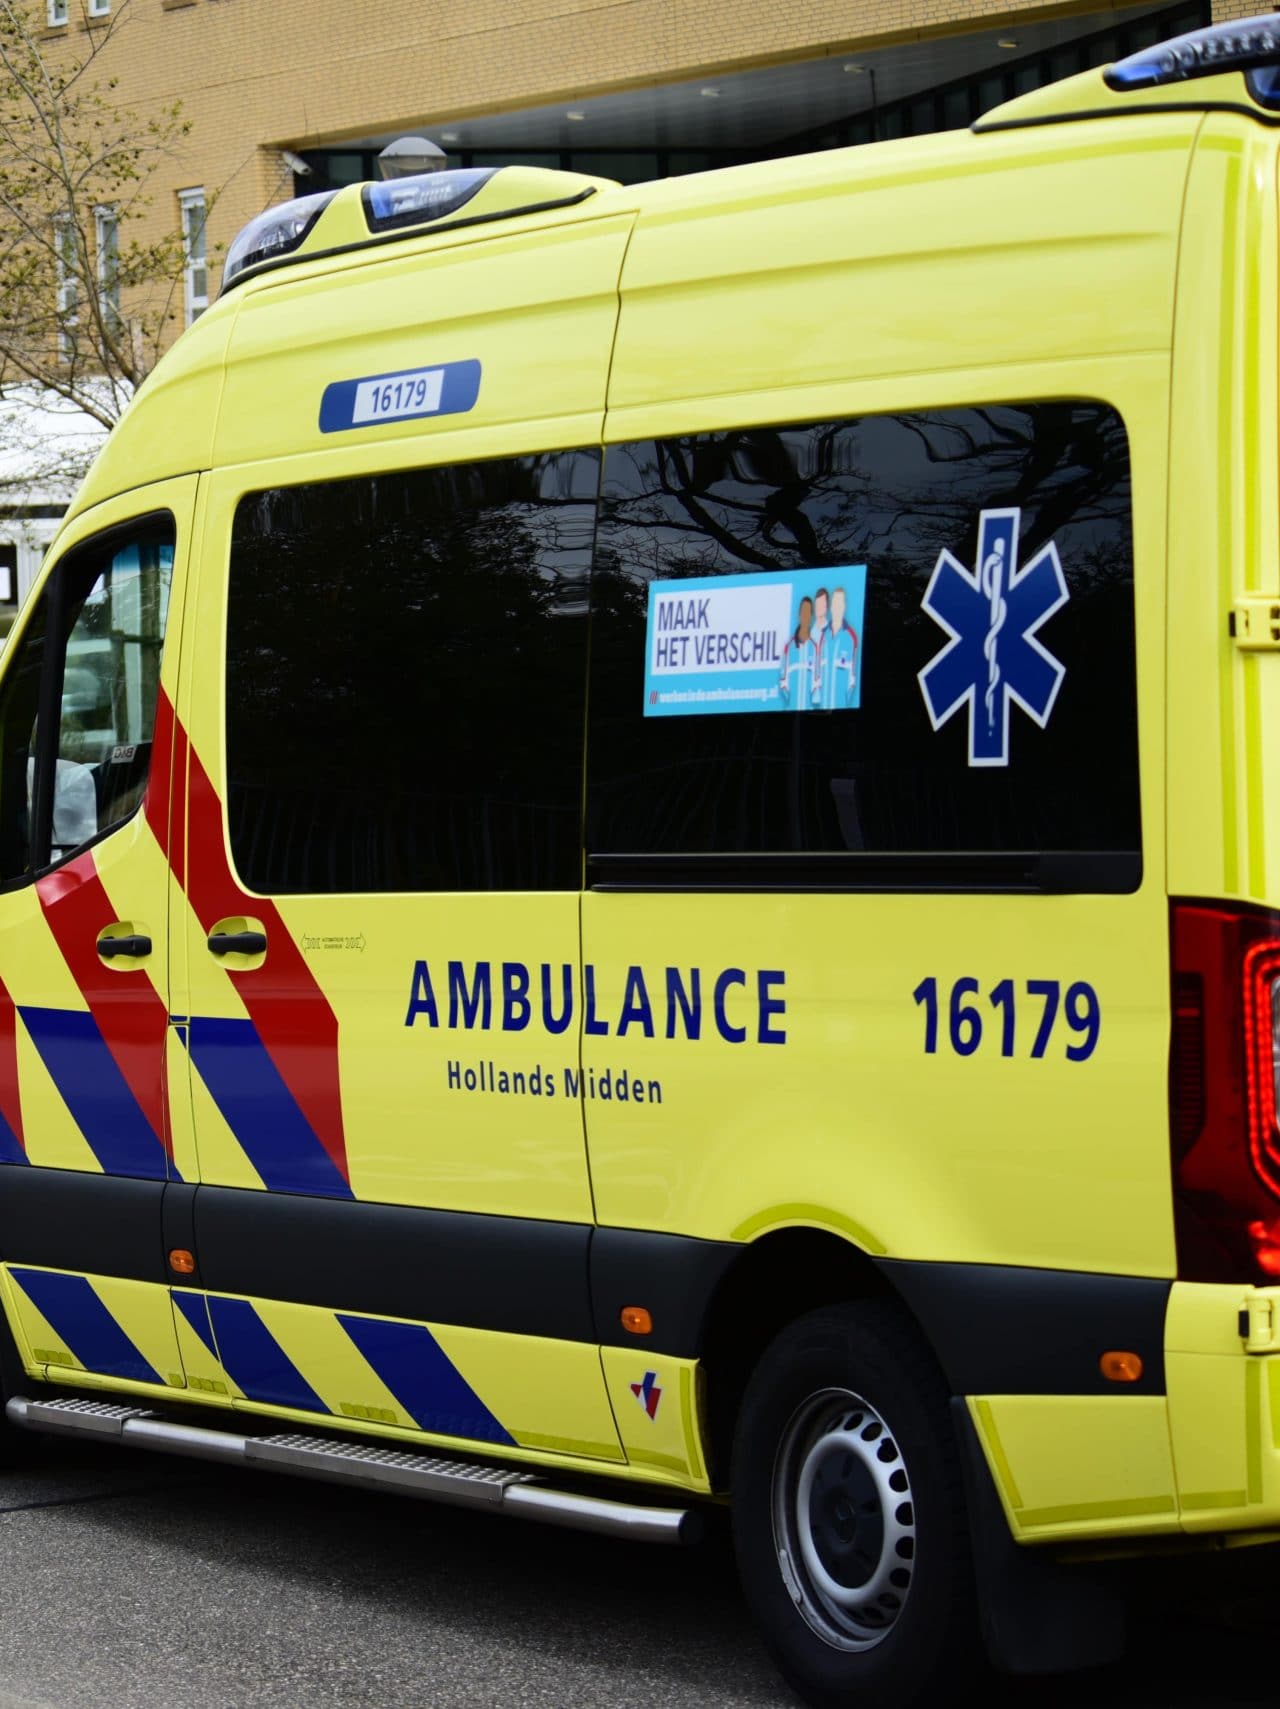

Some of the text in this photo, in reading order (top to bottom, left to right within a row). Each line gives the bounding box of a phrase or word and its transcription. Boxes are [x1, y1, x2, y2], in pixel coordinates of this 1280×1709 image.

[371, 379, 427, 413] 16179
[657, 598, 711, 631] MAAK
[656, 631, 780, 667] HET VERSCHIL
[404, 960, 787, 1045] AMBULANCE
[912, 976, 1101, 1063] 16179
[447, 1060, 663, 1104] Hollands Midden
